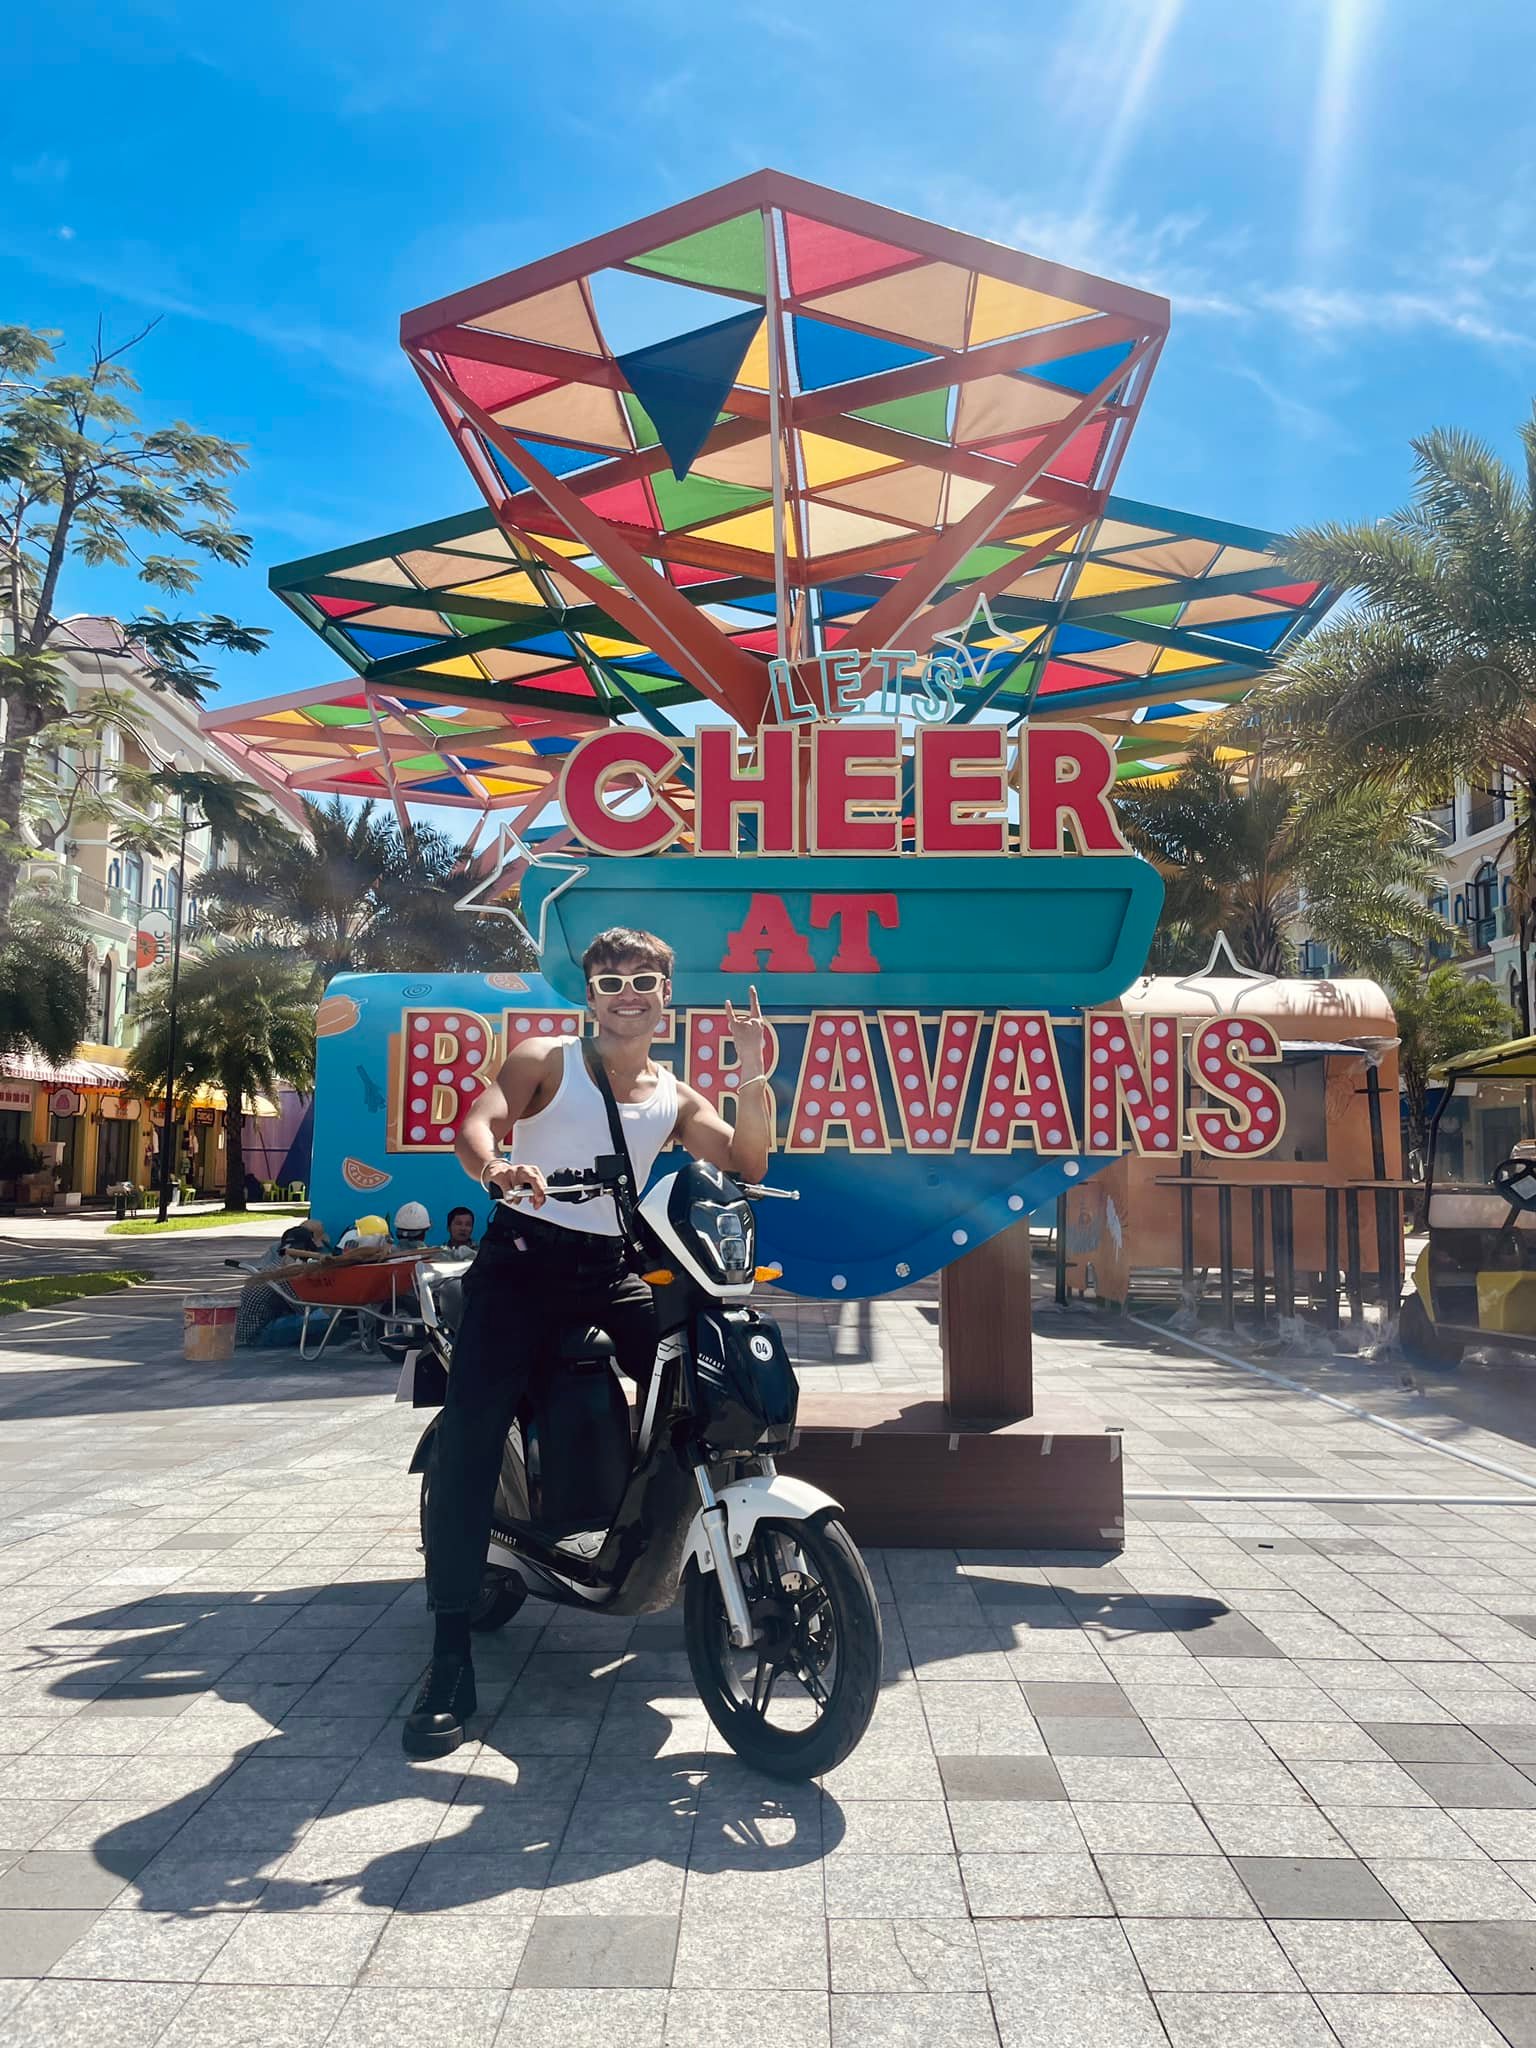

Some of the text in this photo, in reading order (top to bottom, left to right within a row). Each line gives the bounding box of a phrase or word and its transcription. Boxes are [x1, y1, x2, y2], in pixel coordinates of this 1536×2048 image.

[768, 648, 965, 725] LETS
[559, 723, 1135, 859] CHEER
[719, 892, 900, 974] AT
[400, 1007, 1286, 1158] BRAVANS
[755, 1341, 768, 1355] 04
